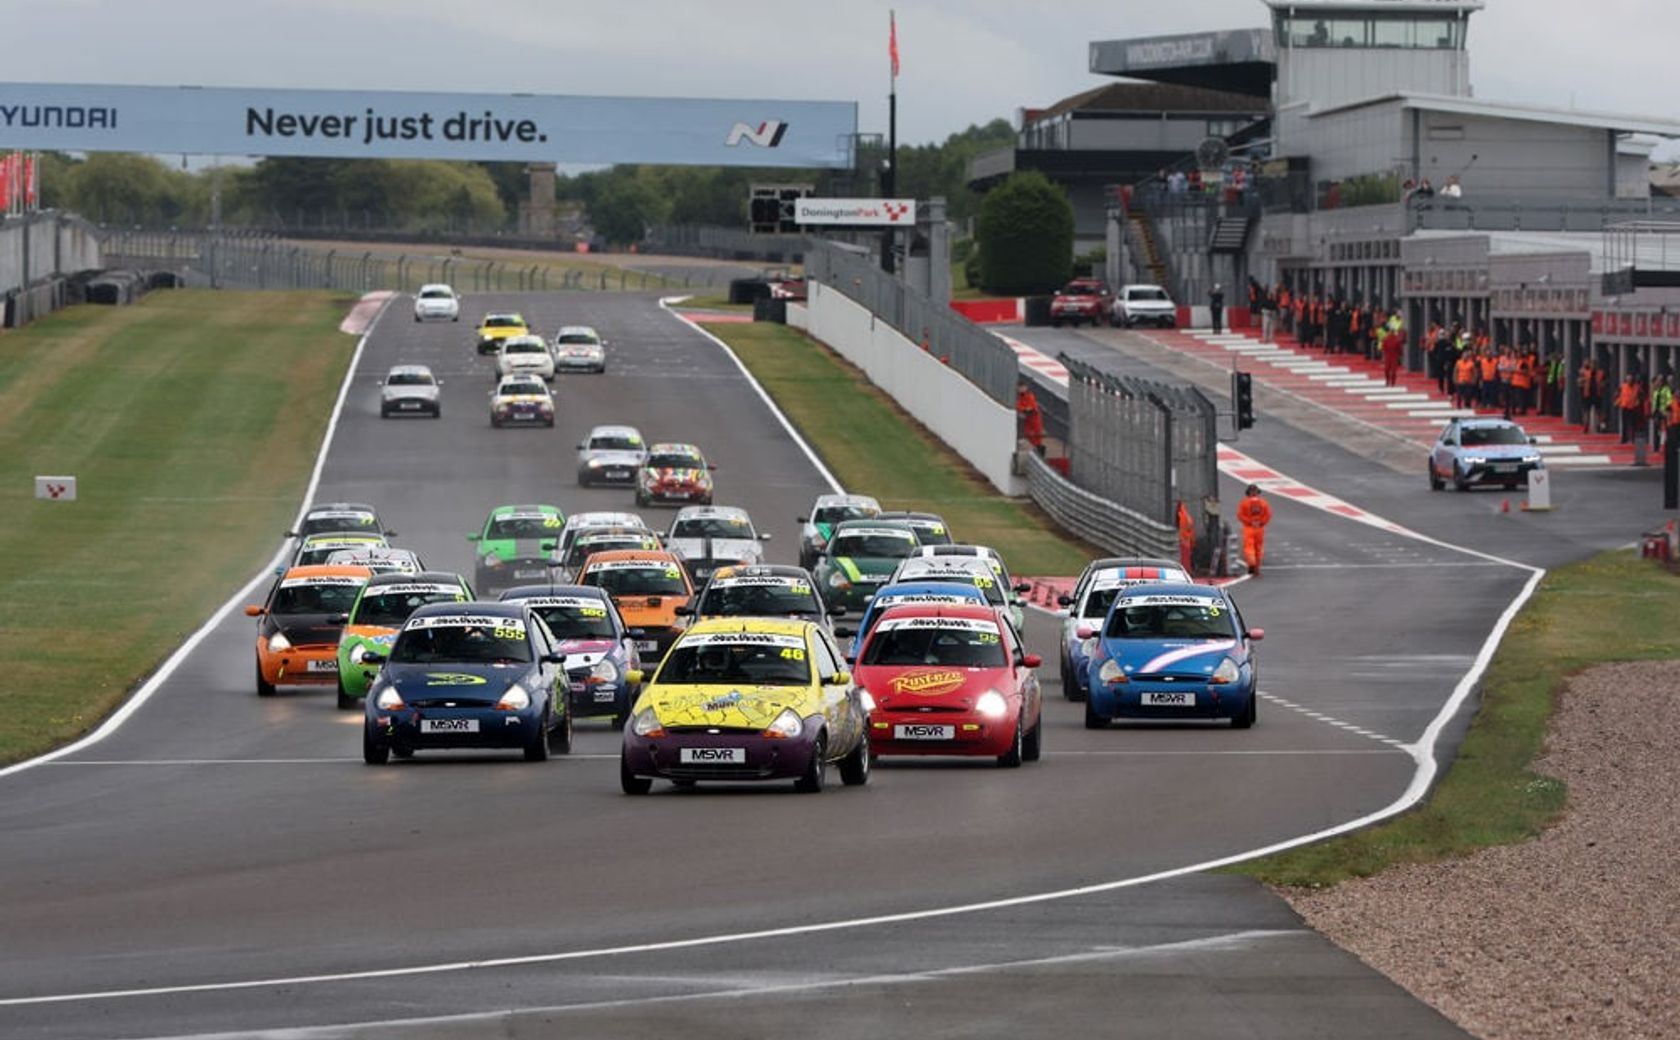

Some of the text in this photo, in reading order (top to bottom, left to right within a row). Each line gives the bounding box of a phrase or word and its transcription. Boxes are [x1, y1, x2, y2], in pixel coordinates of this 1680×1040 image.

[246, 107, 547, 144] Never just drive.
[494, 626, 525, 640] 555
[780, 647, 805, 661] 46
[430, 720, 470, 730] MSVR
[904, 725, 944, 736] MSVR
[691, 749, 735, 760] MSVR
